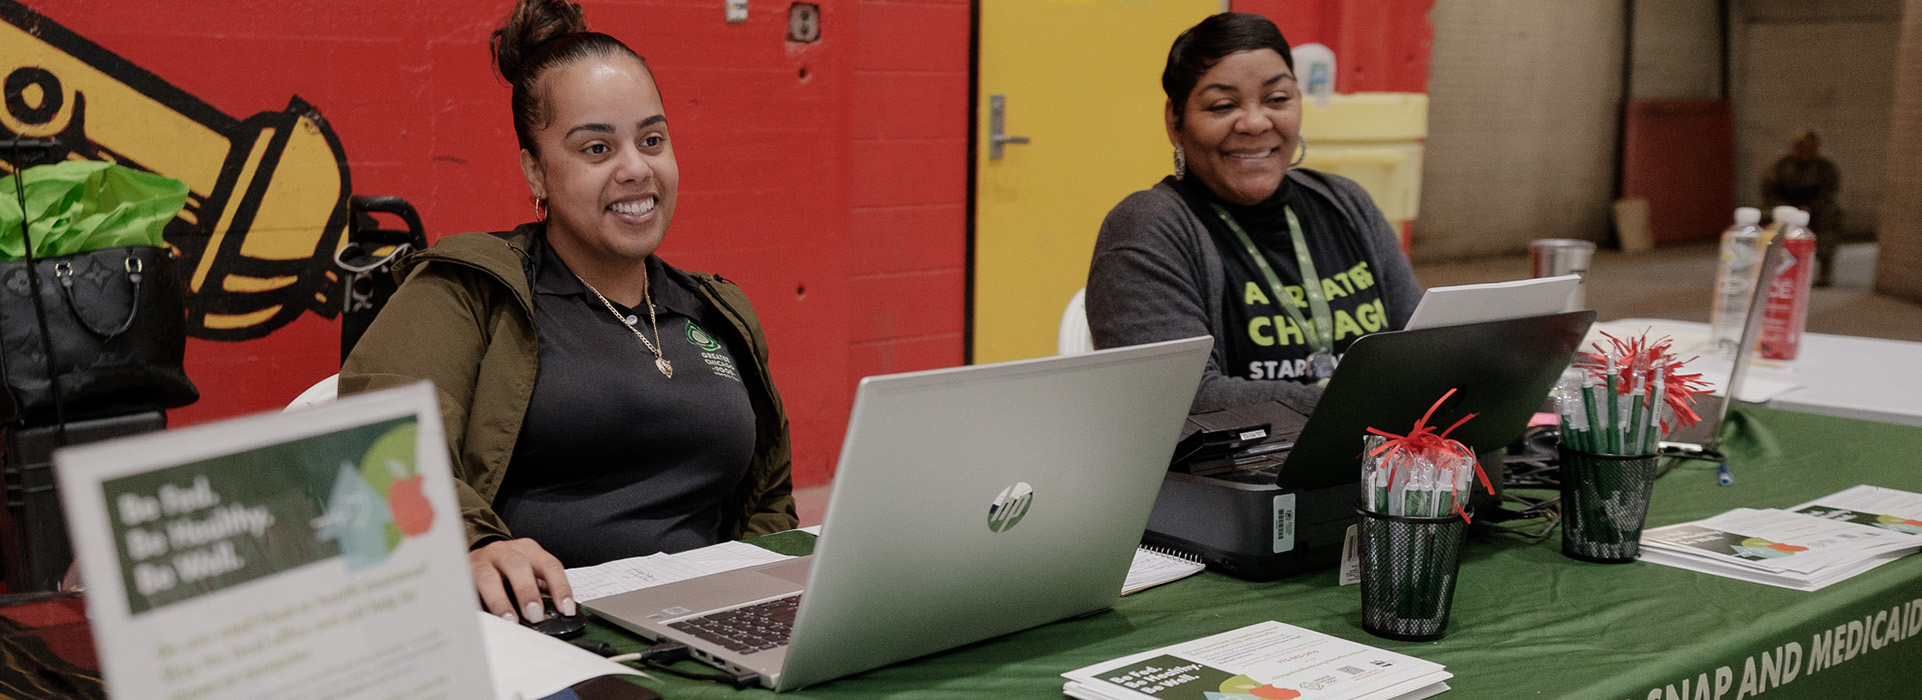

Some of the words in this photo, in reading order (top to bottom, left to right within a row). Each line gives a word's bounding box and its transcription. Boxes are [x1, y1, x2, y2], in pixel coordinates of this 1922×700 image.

[1244, 281, 1270, 305] A
[1247, 298, 1389, 347] CHAG
[989, 482, 1033, 533] hp
[1736, 641, 1803, 700] AND
[1806, 598, 1922, 676] MEDICAID
[1109, 674, 1133, 684] Be
[1128, 665, 1163, 678] Fed.
[1123, 679, 1148, 689] Be
[1142, 663, 1203, 683] Healthy.
[1140, 684, 1165, 694] Be
[1158, 673, 1200, 688] Well.
